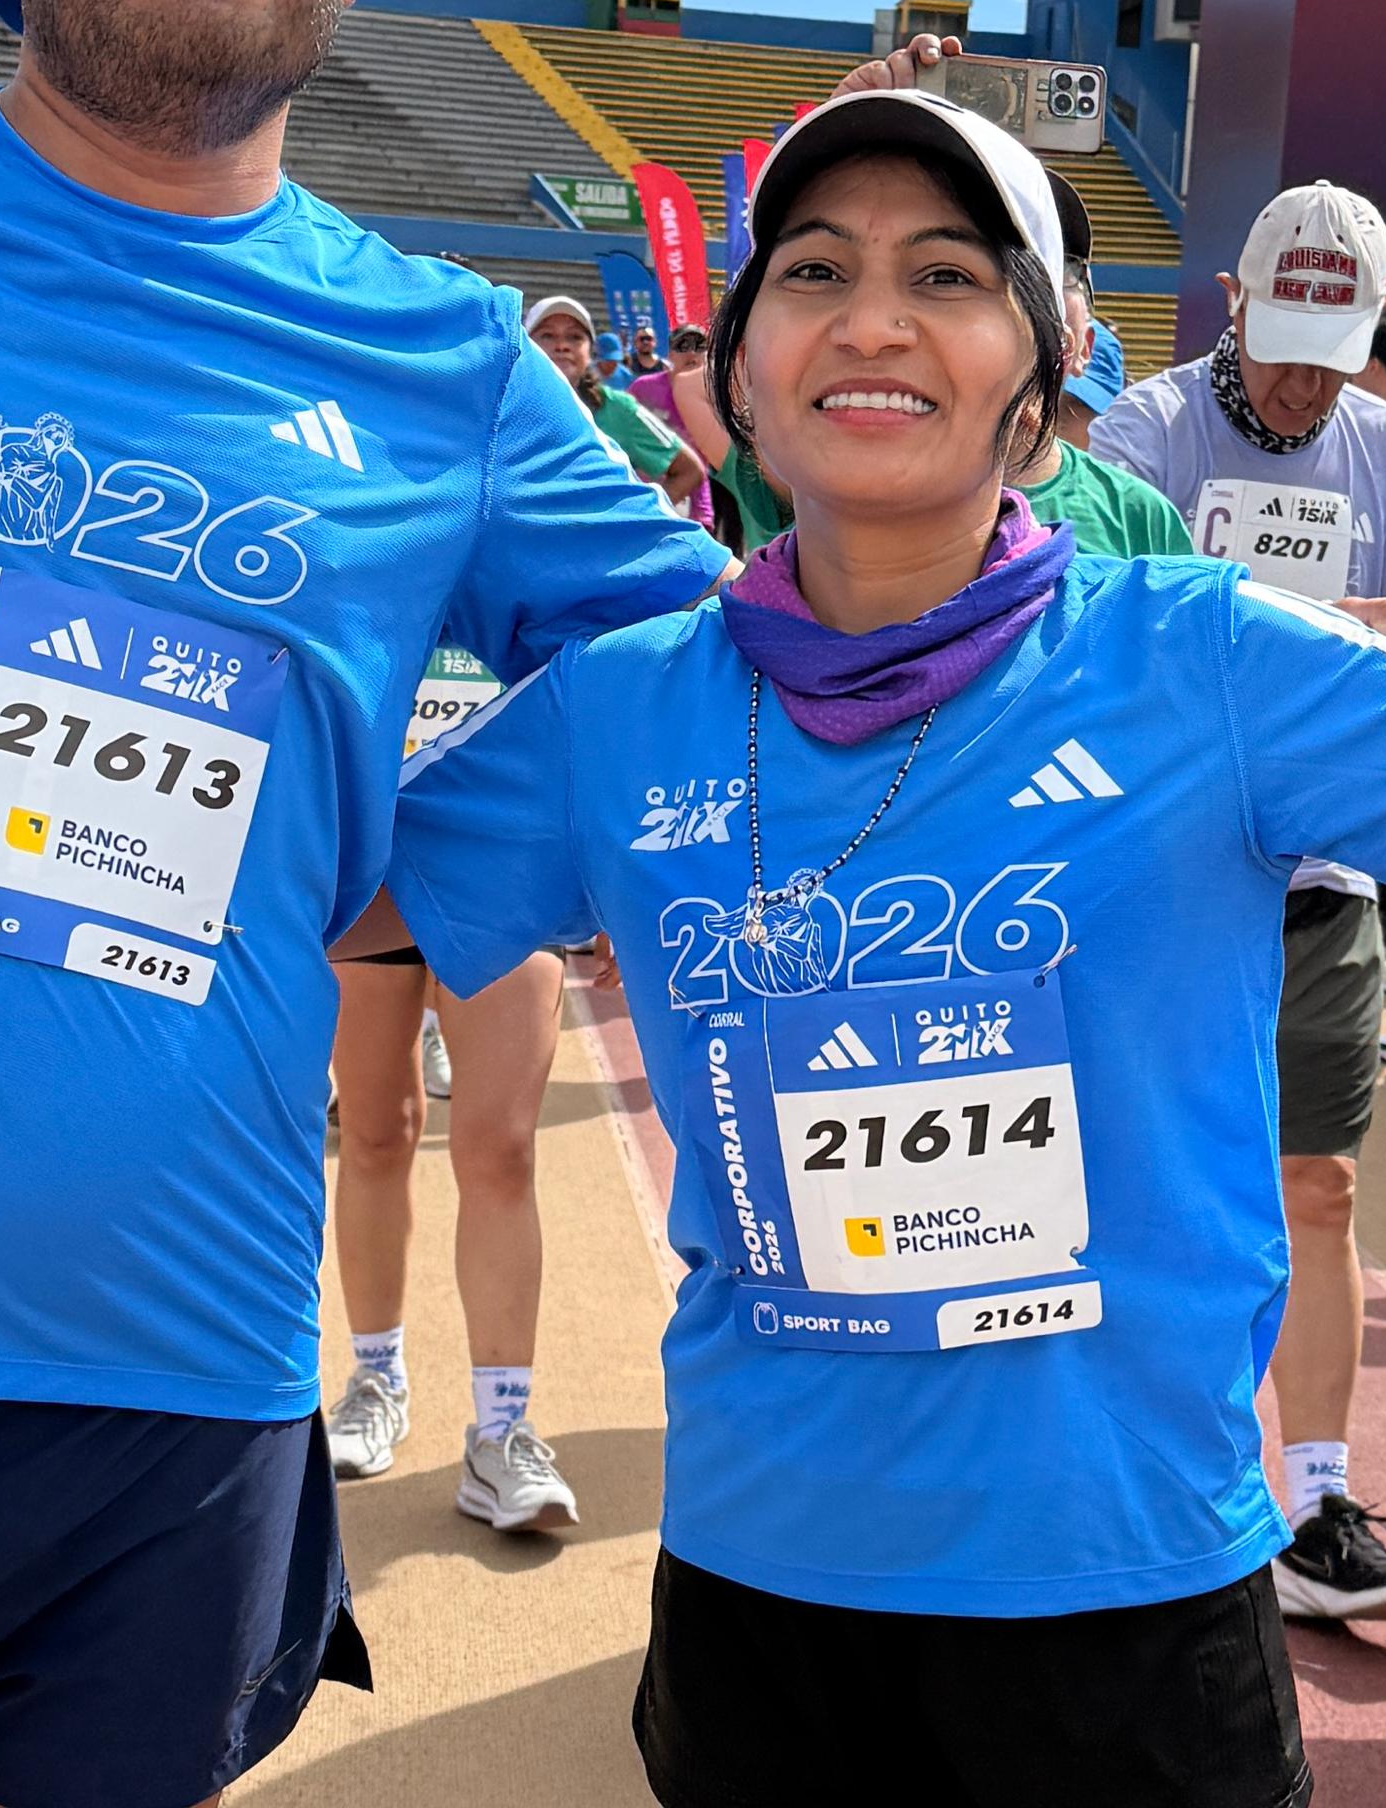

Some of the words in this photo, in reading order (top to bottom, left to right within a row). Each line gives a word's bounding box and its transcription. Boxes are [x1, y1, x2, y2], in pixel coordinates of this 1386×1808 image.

[1202, 506, 1232, 559] C
[1254, 533, 1329, 562] 8201
[151, 635, 242, 675] QUITO
[645, 777, 747, 807] QUITO
[60, 819, 149, 858] BANCO
[55, 843, 186, 895] PICHINCHA
[659, 861, 1070, 1010] 2026
[100, 944, 191, 988] 21613
[708, 1011, 745, 1029] CORRAL
[915, 1000, 1012, 1026] QUITO
[803, 1095, 1056, 1171] 21614
[708, 1037, 769, 1276] CORPORATIVO
[892, 1205, 981, 1232] BANCO
[761, 1220, 786, 1276] 2026
[895, 1222, 1035, 1256] PICHINCHA
[783, 1313, 841, 1333] SPORT
[847, 1318, 891, 1335] BAG
[973, 1298, 1075, 1333] 21614
